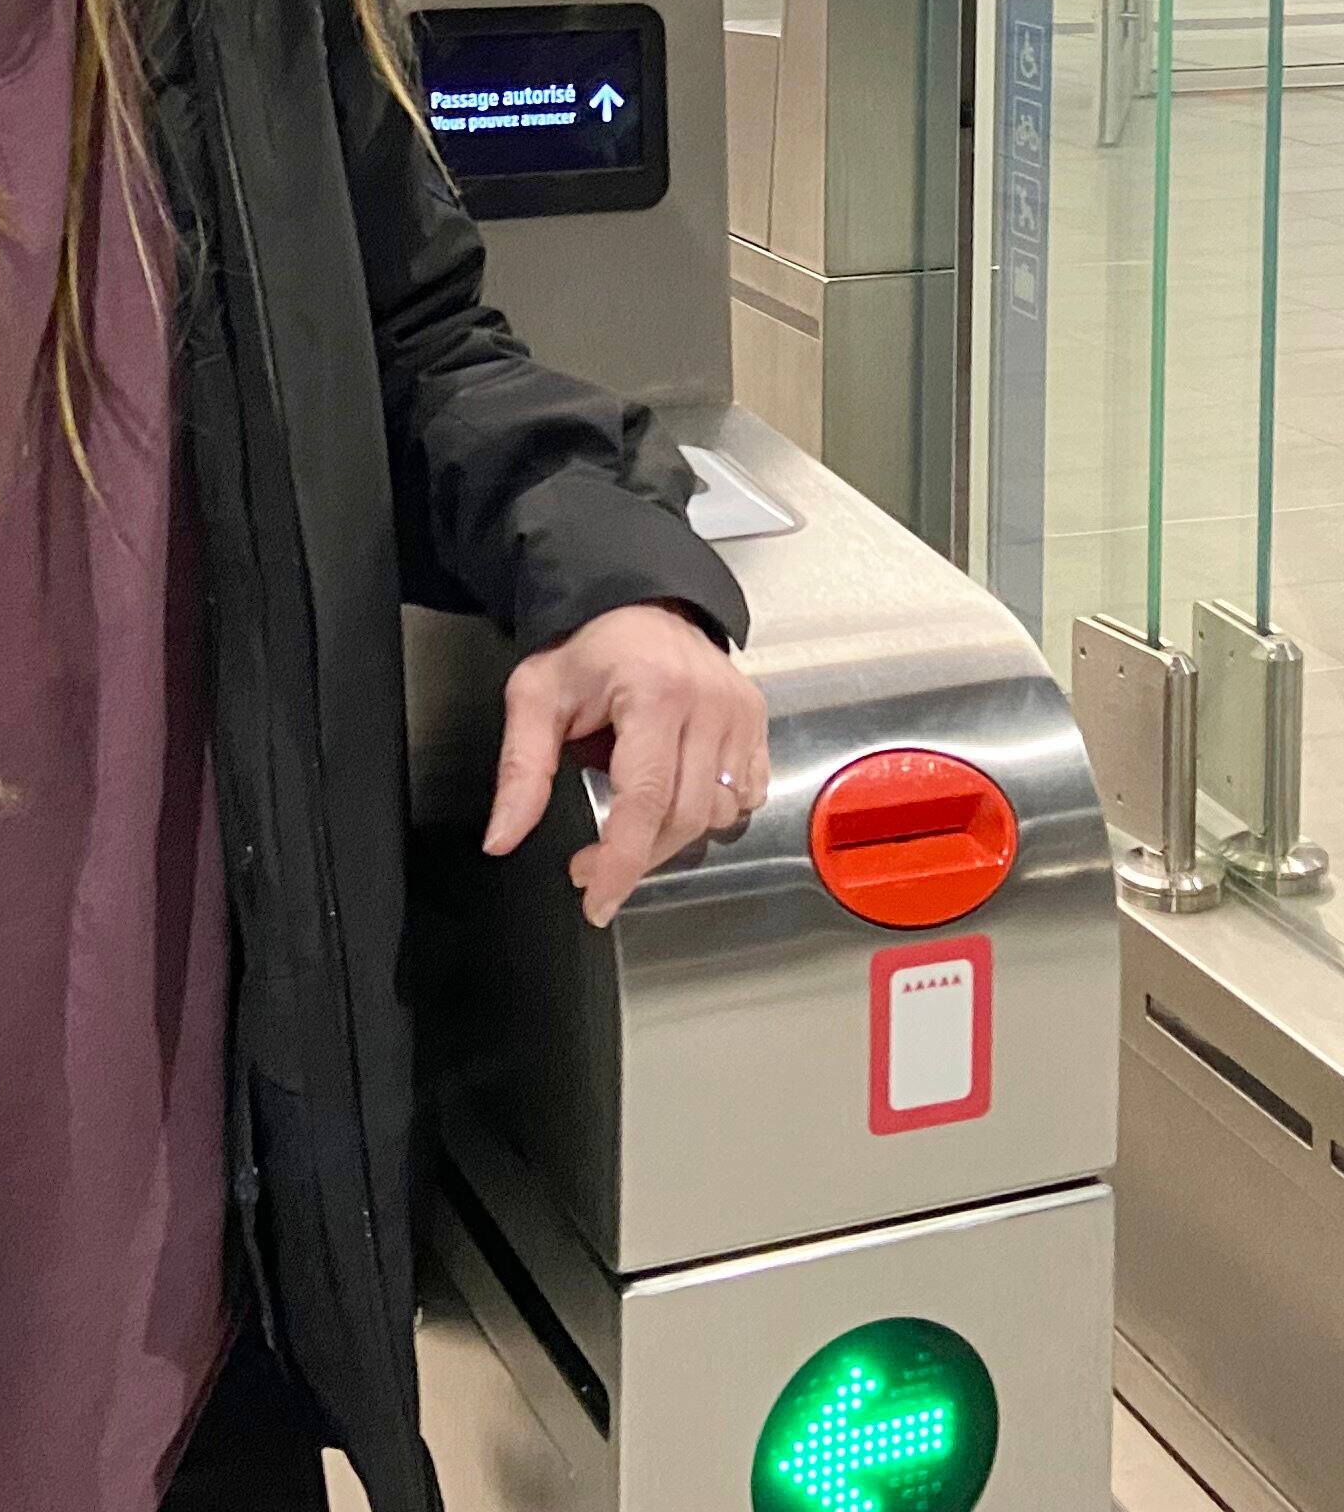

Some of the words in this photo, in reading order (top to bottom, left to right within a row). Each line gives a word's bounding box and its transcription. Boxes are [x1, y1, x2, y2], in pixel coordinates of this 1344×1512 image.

[430, 91, 499, 111] Passage
[502, 83, 576, 106] autorisé
[430, 116, 467, 130] Vous
[468, 114, 520, 133] pouvez
[520, 112, 577, 127] avancer
